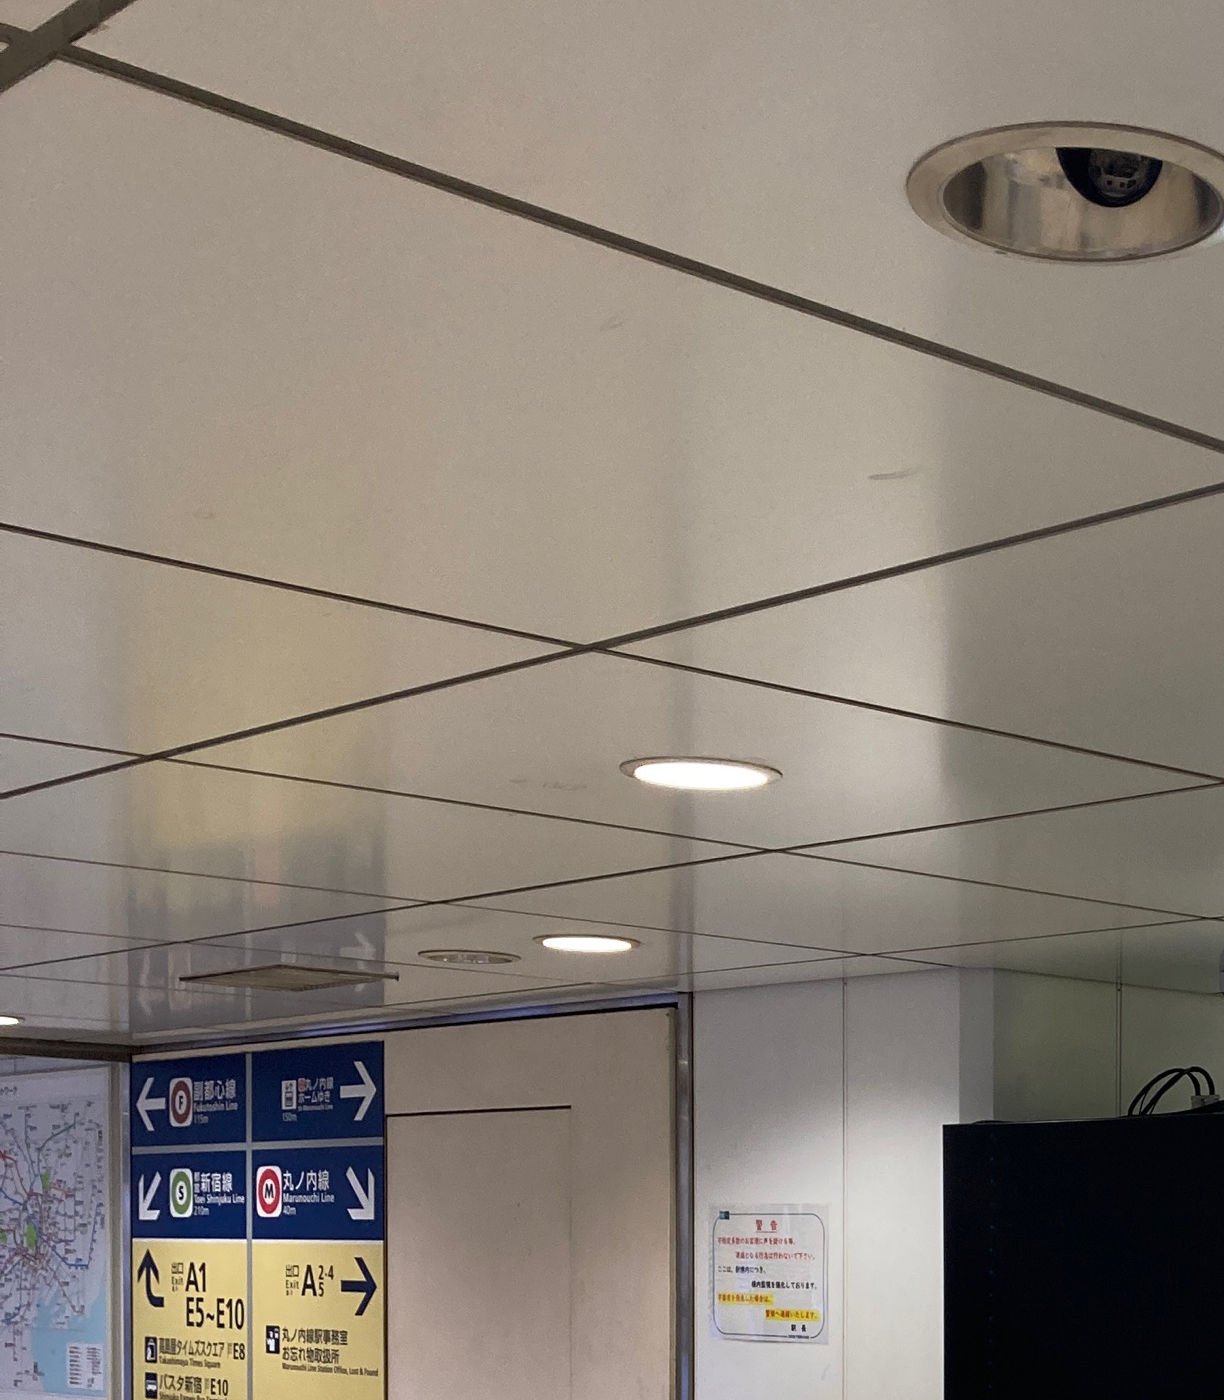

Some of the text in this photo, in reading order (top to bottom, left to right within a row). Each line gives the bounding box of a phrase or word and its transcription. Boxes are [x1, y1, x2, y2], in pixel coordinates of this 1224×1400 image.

[201, 1172, 232, 1192] 新宿線
[283, 1170, 330, 1191] 丸ノ内線
[232, 1194, 244, 1204] Line
[264, 1183, 274, 1199] M
[283, 1192, 335, 1203] Marunouchi Line
[171, 1262, 184, 1274] 出口
[286, 1264, 299, 1277] 出口
[185, 1262, 206, 1292] A1
[286, 1280, 299, 1289] Exit
[301, 1264, 317, 1296] A
[282, 1327, 348, 1345] 丸ノ内線駅事務室
[233, 1343, 245, 1360] E8
[282, 1347, 340, 1364] お忘れ物取扱所
[160, 1374, 202, 1394] バスタ新宿
[211, 1379, 228, 1396] E10
